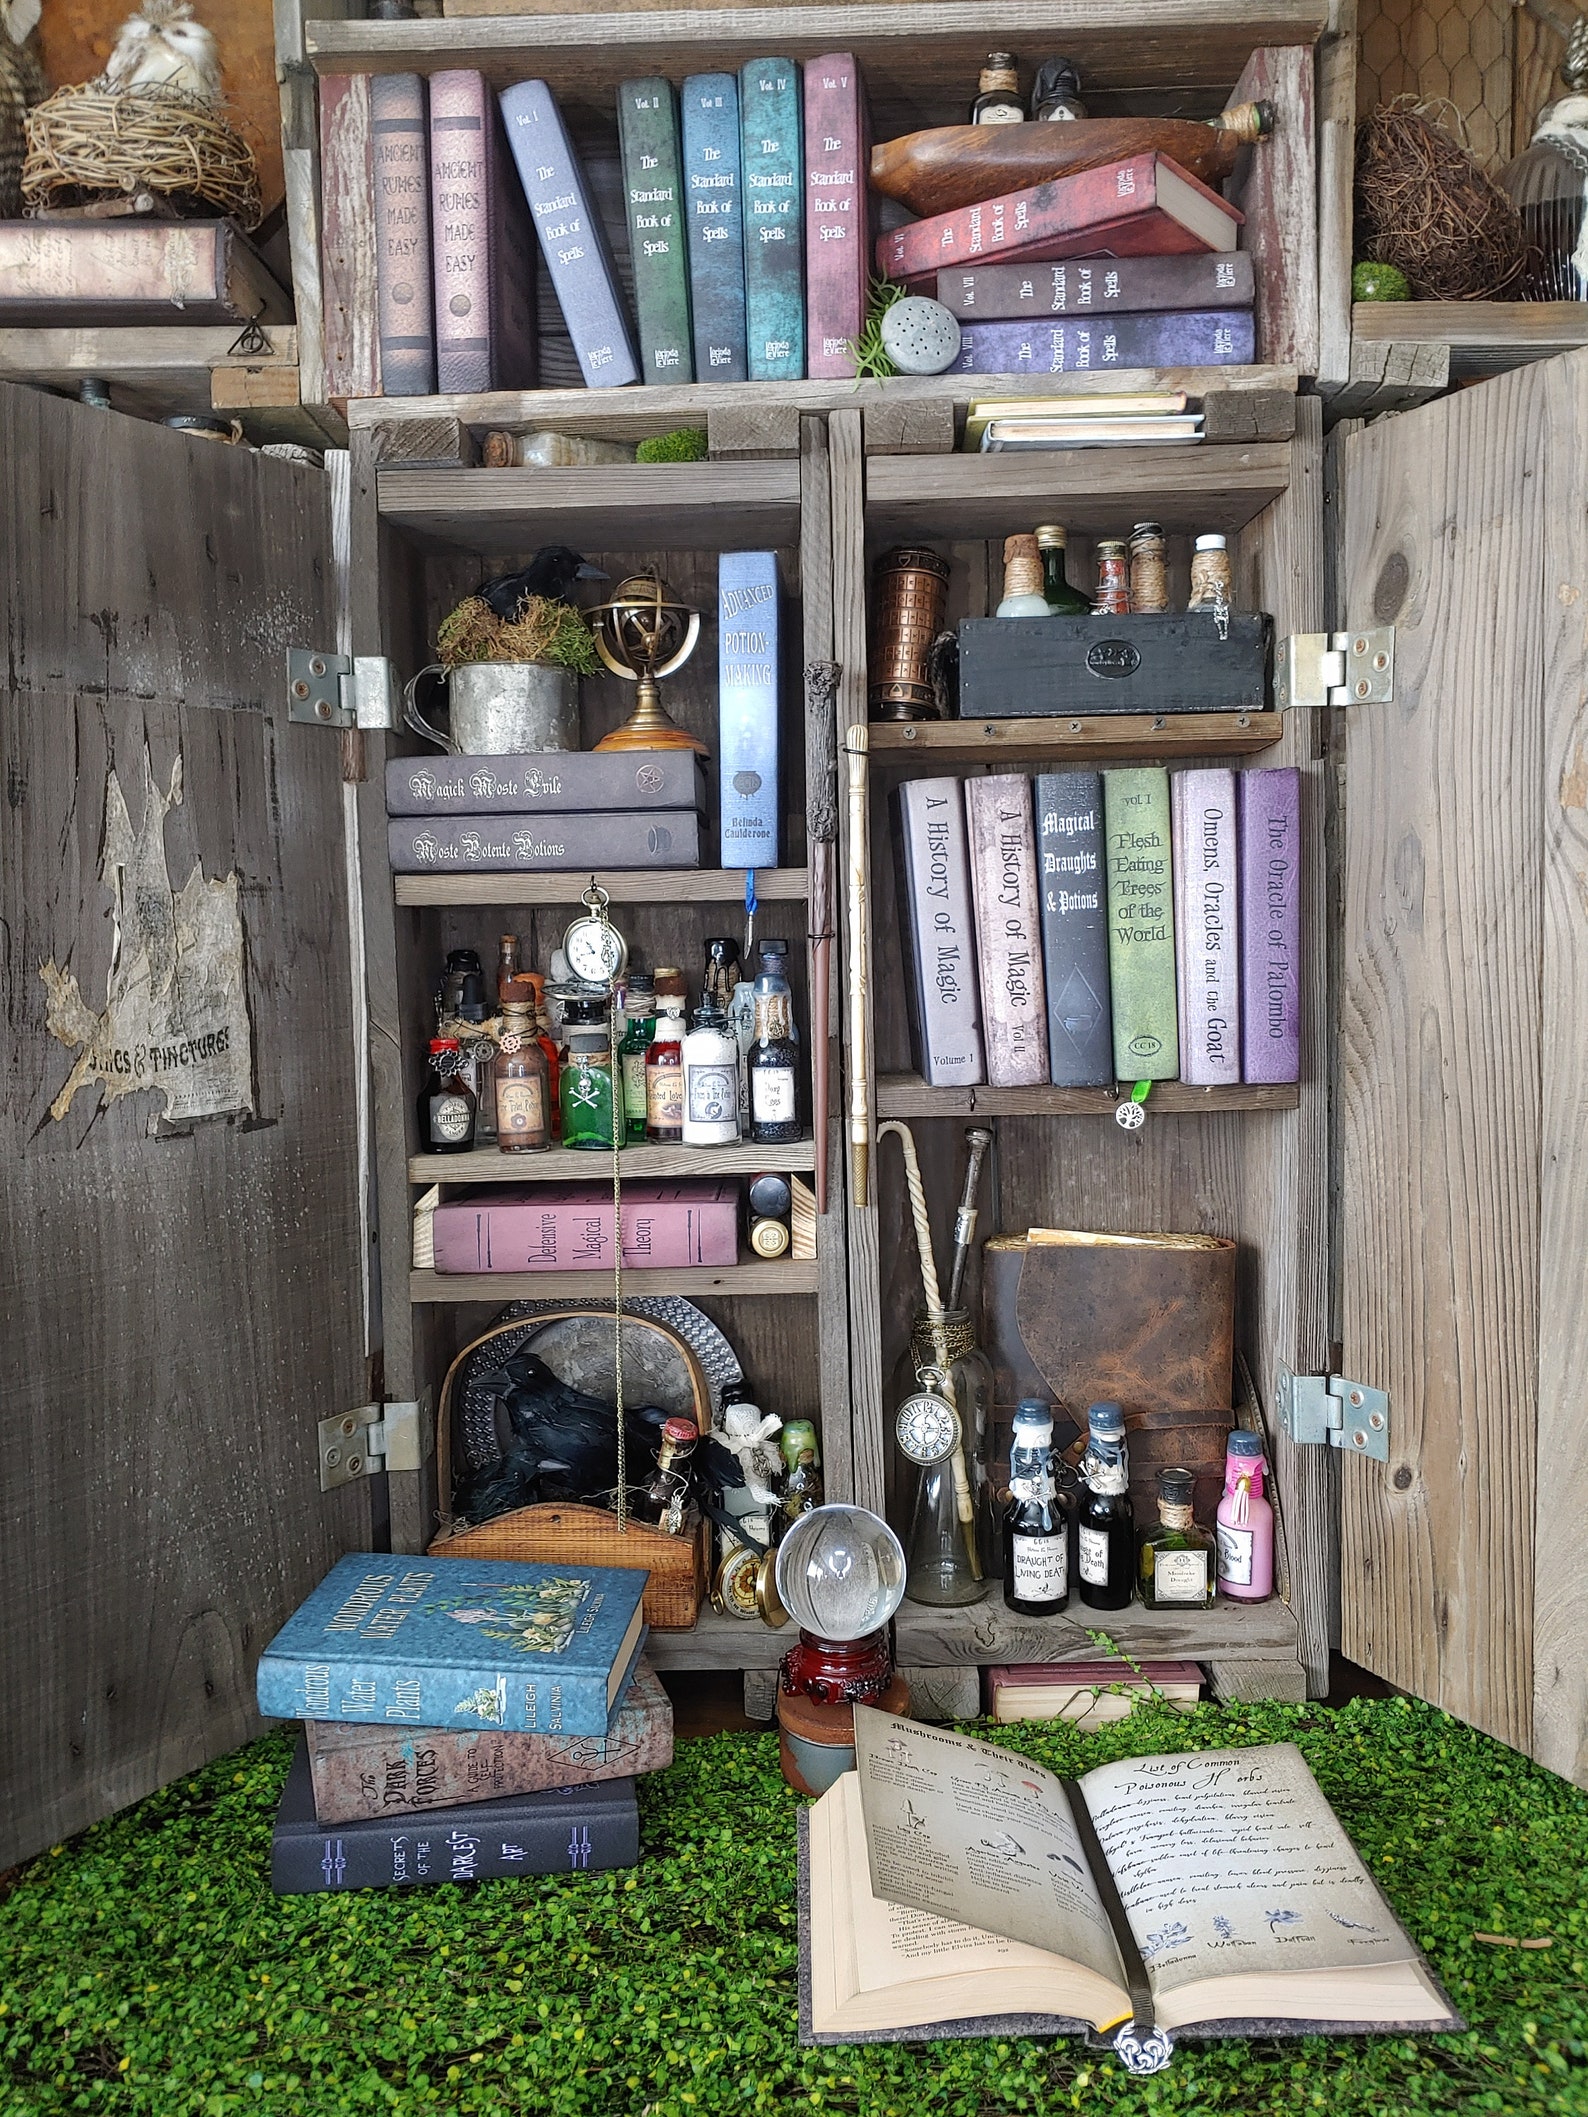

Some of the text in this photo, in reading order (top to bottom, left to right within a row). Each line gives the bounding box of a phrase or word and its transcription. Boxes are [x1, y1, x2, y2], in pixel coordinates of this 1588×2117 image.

[761, 139, 779, 153] The
[824, 137, 841, 151] The
[640, 155, 658, 169] The
[703, 147, 721, 161] The
[435, 161, 483, 179] ANCIENT
[536, 166, 555, 181] The
[810, 170, 854, 187] Standard
[691, 173, 734, 188] Standard
[749, 172, 793, 188] Standard
[439, 193, 481, 211] RUNES
[630, 187, 673, 203] Standard
[534, 193, 577, 217] Standard
[697, 200, 732, 214] Book of
[754, 200, 790, 213] Book of
[815, 198, 851, 212] Book of
[387, 207, 418, 225] MADE
[636, 214, 672, 228] Book of
[992, 205, 1004, 242] Book of
[1015, 201, 1026, 231] Spells
[444, 224, 476, 241] MADE
[545, 218, 580, 239] Book of
[703, 226, 728, 242] Spells
[759, 227, 785, 243] Spells
[819, 225, 846, 242] Spells
[941, 227, 953, 247] The
[970, 207, 982, 253] Standard
[387, 239, 418, 256] EASY
[557, 248, 585, 265] Spells
[643, 240, 669, 256] Spells
[446, 254, 476, 272] EASY
[1019, 280, 1033, 299] The
[1052, 266, 1066, 310] Standard
[1078, 268, 1091, 305] Book of
[1104, 271, 1118, 298] Spells
[1019, 342, 1032, 360] The
[1050, 329, 1064, 373] Standard
[1076, 331, 1091, 368] Book of
[1104, 335, 1117, 362] Spells
[725, 663, 772, 688] MAKING
[732, 817, 762, 827] Belinda
[1001, 809, 1022, 821] A
[1042, 811, 1095, 836] Magical
[1109, 832, 1163, 851] Flesh
[998, 833, 1022, 908] History
[1044, 851, 1096, 874] Draughts
[1110, 857, 1165, 874] Eating
[1111, 880, 1165, 896] Trees
[926, 797, 961, 1003] A History of Magic
[1047, 890, 1098, 915] & Potions
[1118, 903, 1163, 920] of the
[1006, 919, 1025, 940] of
[1113, 926, 1171, 944] World
[1203, 808, 1227, 1063] Omens, Oracles and the Goat
[1267, 816, 1289, 1039] The Oracle of Palombo
[1008, 950, 1032, 1007] Magic
[1013, 1025, 1024, 1042] Vol
[933, 1055, 966, 1066] Volume
[528, 1214, 558, 1264] Defensive
[573, 1216, 602, 1261] Magical
[623, 1217, 655, 1258] Theory
[1017, 1553, 1063, 1567] DRAUGHT OF
[1015, 1565, 1041, 1579] LIVING
[324, 1574, 394, 1633] WONDROUS
[360, 1571, 435, 1640] WATER PLANTS
[296, 1664, 331, 1719] Wondrous
[342, 1678, 377, 1714] Water
[387, 1679, 420, 1720] Plants
[525, 1682, 536, 1728] LILEIGH
[549, 1684, 563, 1730] SALVINIA
[890, 1721, 963, 1748] Mushrooms
[981, 1747, 1014, 1765] Their
[468, 1749, 477, 1759] TO
[468, 1761, 482, 1784] GUIDE
[1133, 1757, 1240, 1776] List of Common
[375, 1759, 411, 1813] DARK
[1114, 1780, 1187, 1796] Poisonous
[392, 1836, 409, 1882] SECRETS
[418, 1841, 429, 1875] OF THE
[446, 1831, 480, 1879] DARKEST
[499, 1841, 527, 1862] ART
